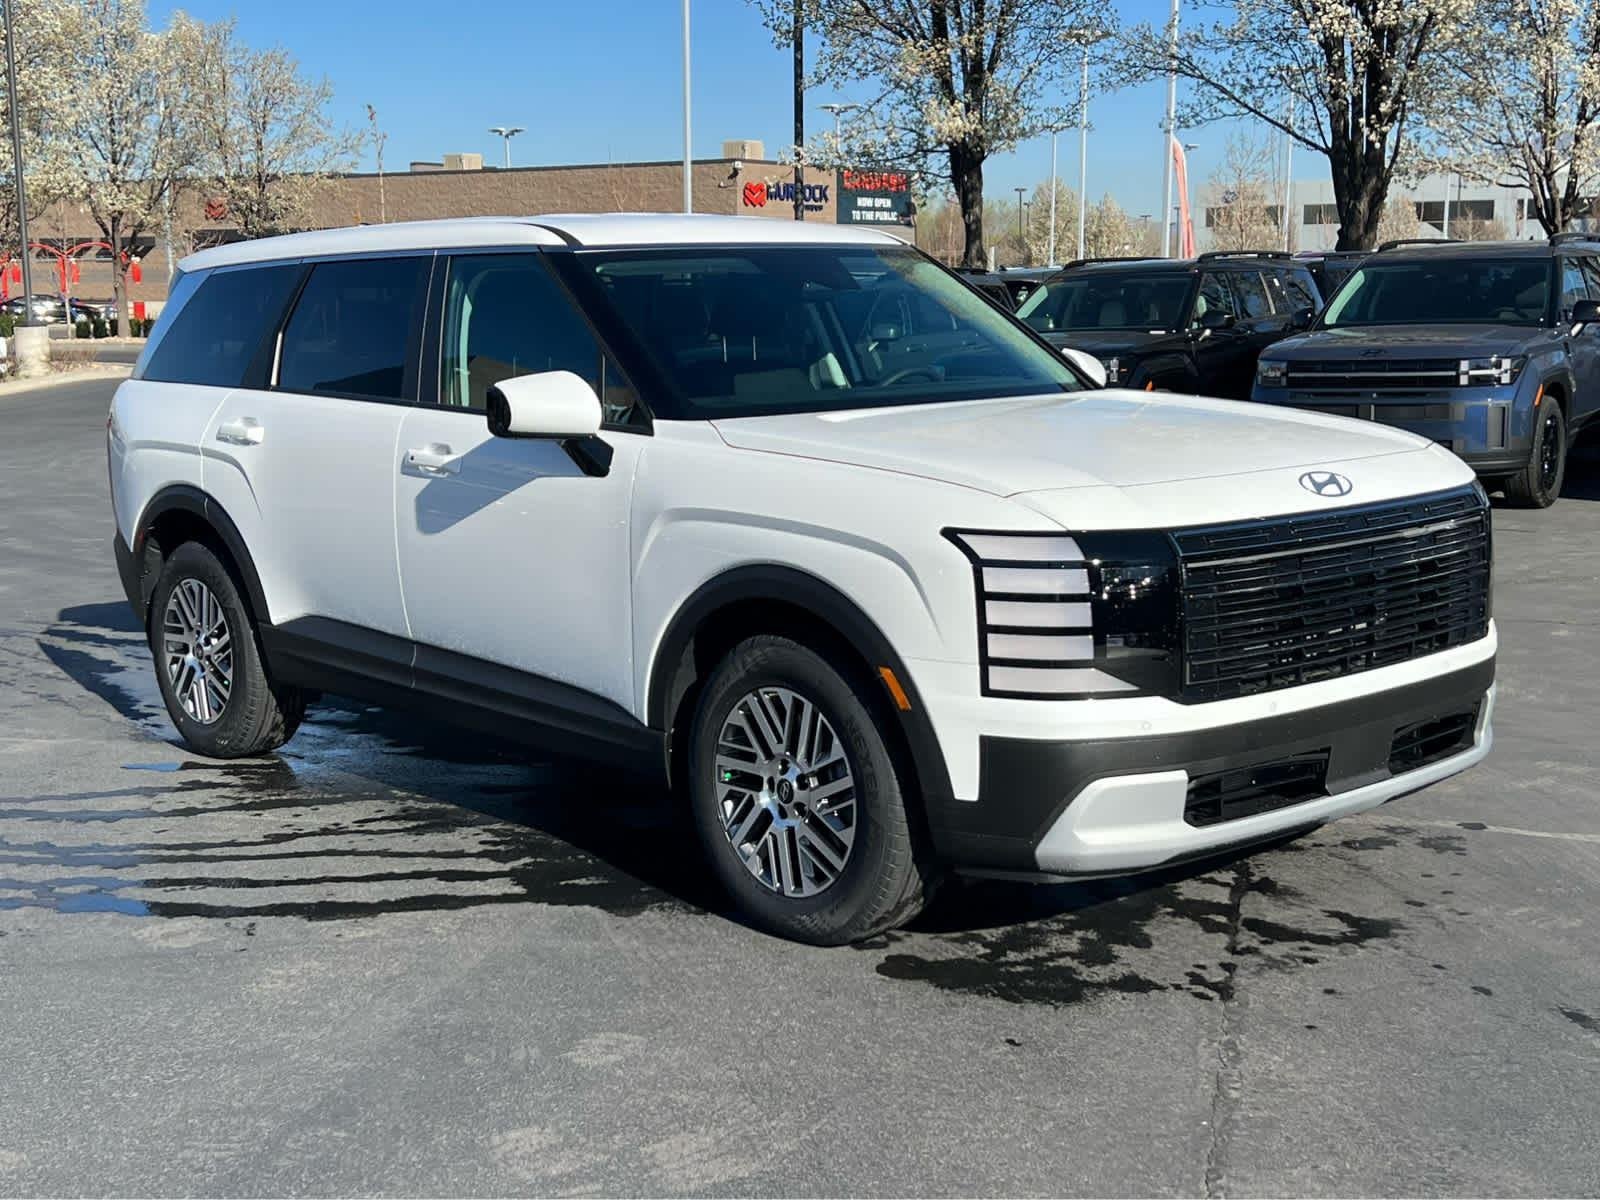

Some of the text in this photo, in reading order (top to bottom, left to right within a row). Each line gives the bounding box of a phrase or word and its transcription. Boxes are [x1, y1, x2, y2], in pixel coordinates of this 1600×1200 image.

[766, 183, 829, 203] MUROCK
[857, 197, 891, 208] NOW OPEN
[852, 210, 898, 221] TO THE PUBLIC
